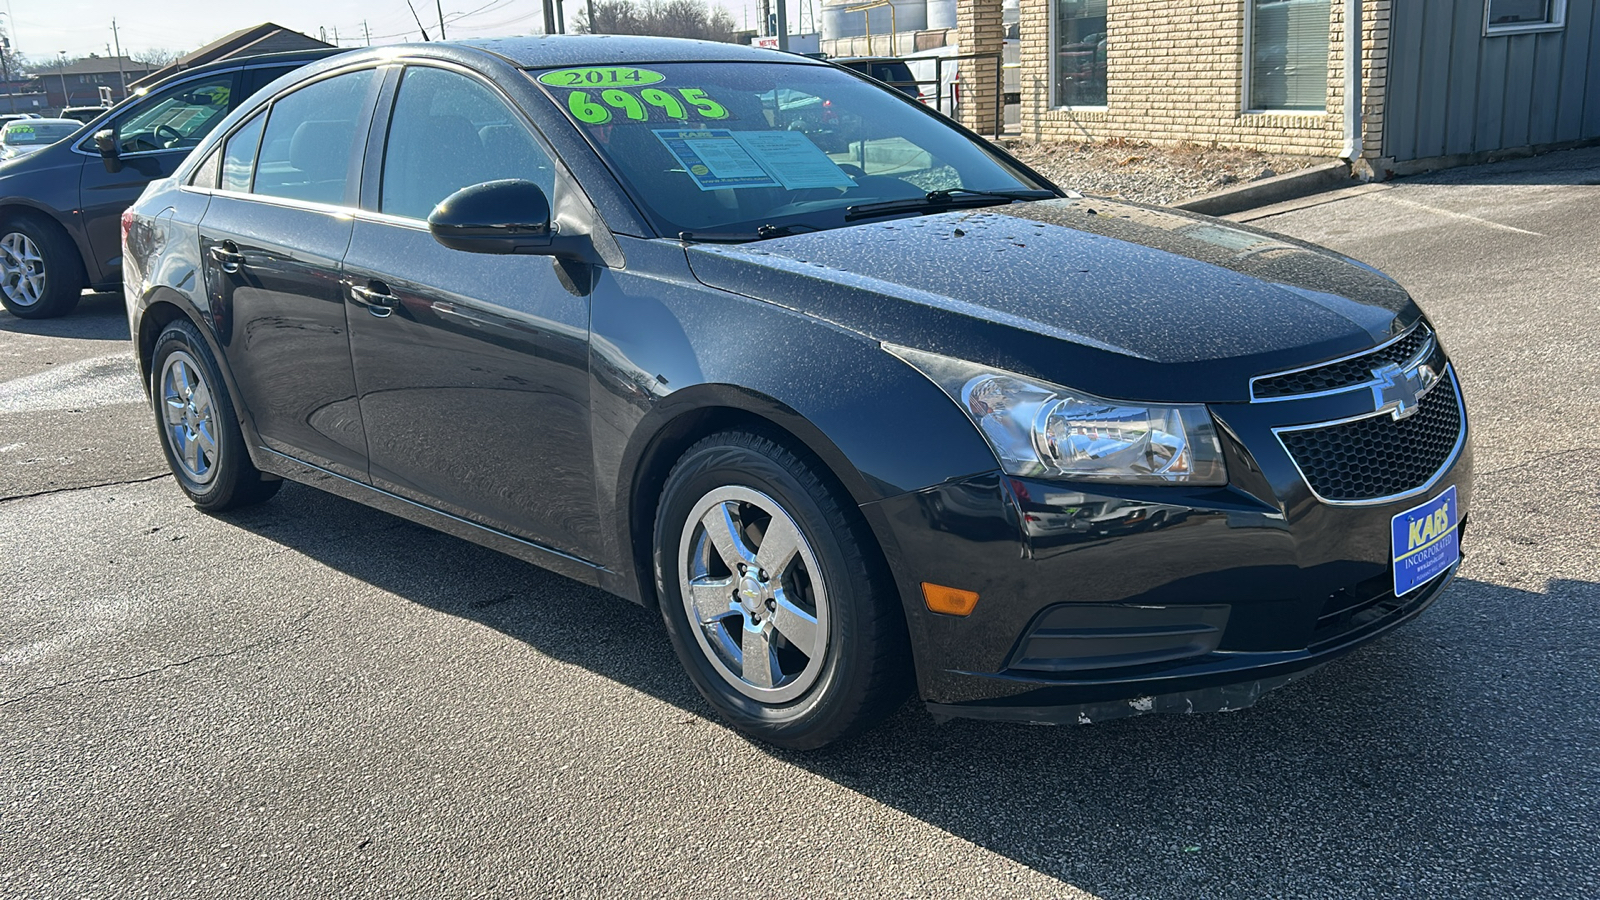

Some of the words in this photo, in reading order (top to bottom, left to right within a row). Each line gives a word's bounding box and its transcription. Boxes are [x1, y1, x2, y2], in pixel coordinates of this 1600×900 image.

[565, 70, 642, 85] 2014
[568, 88, 730, 125] 6995
[678, 131, 713, 139] KARS
[1408, 503, 1448, 550] KARS
[1405, 534, 1452, 569] INCORPORATED
